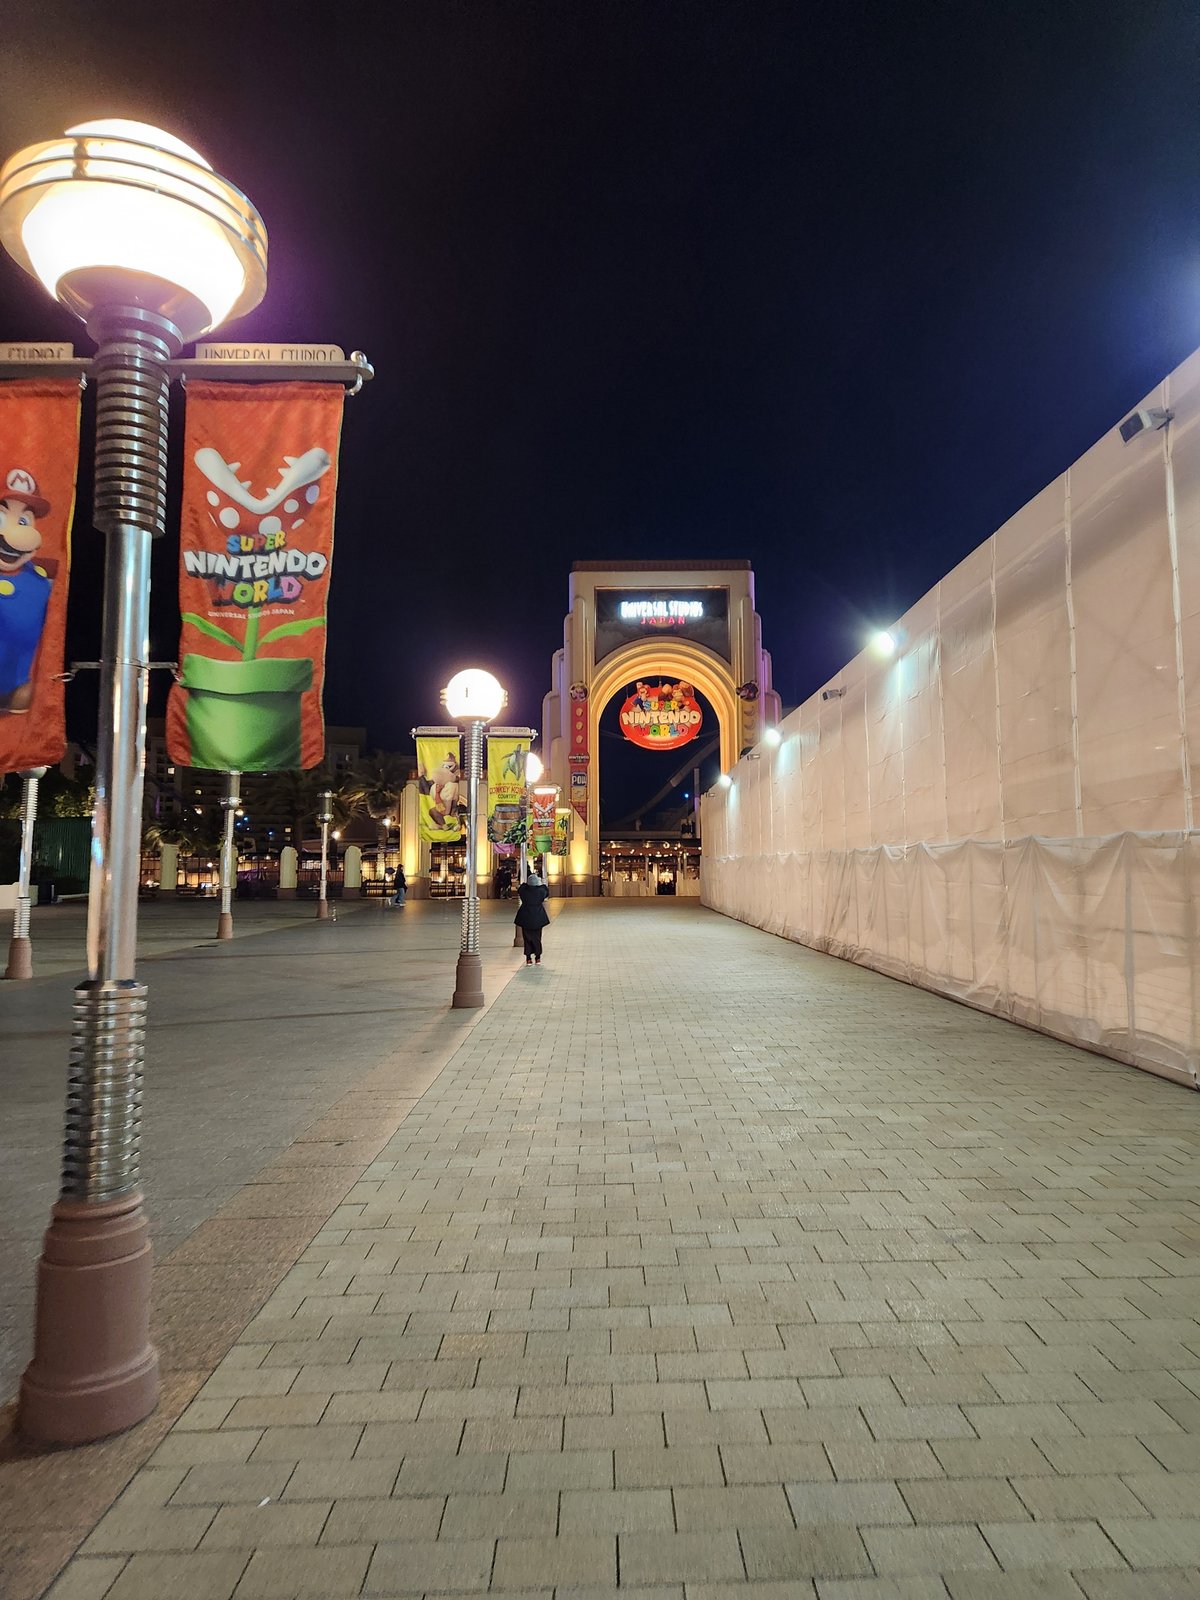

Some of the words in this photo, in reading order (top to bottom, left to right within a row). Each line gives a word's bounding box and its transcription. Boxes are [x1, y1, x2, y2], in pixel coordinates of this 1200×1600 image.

[226, 530, 287, 554] SUPER
[183, 549, 328, 579] NINTENDO
[206, 575, 303, 607] WORLD
[640, 616, 686, 625] JAPAN
[642, 699, 679, 712] SUPER
[621, 710, 701, 725] NINTENDO
[634, 723, 690, 737] WORLD
